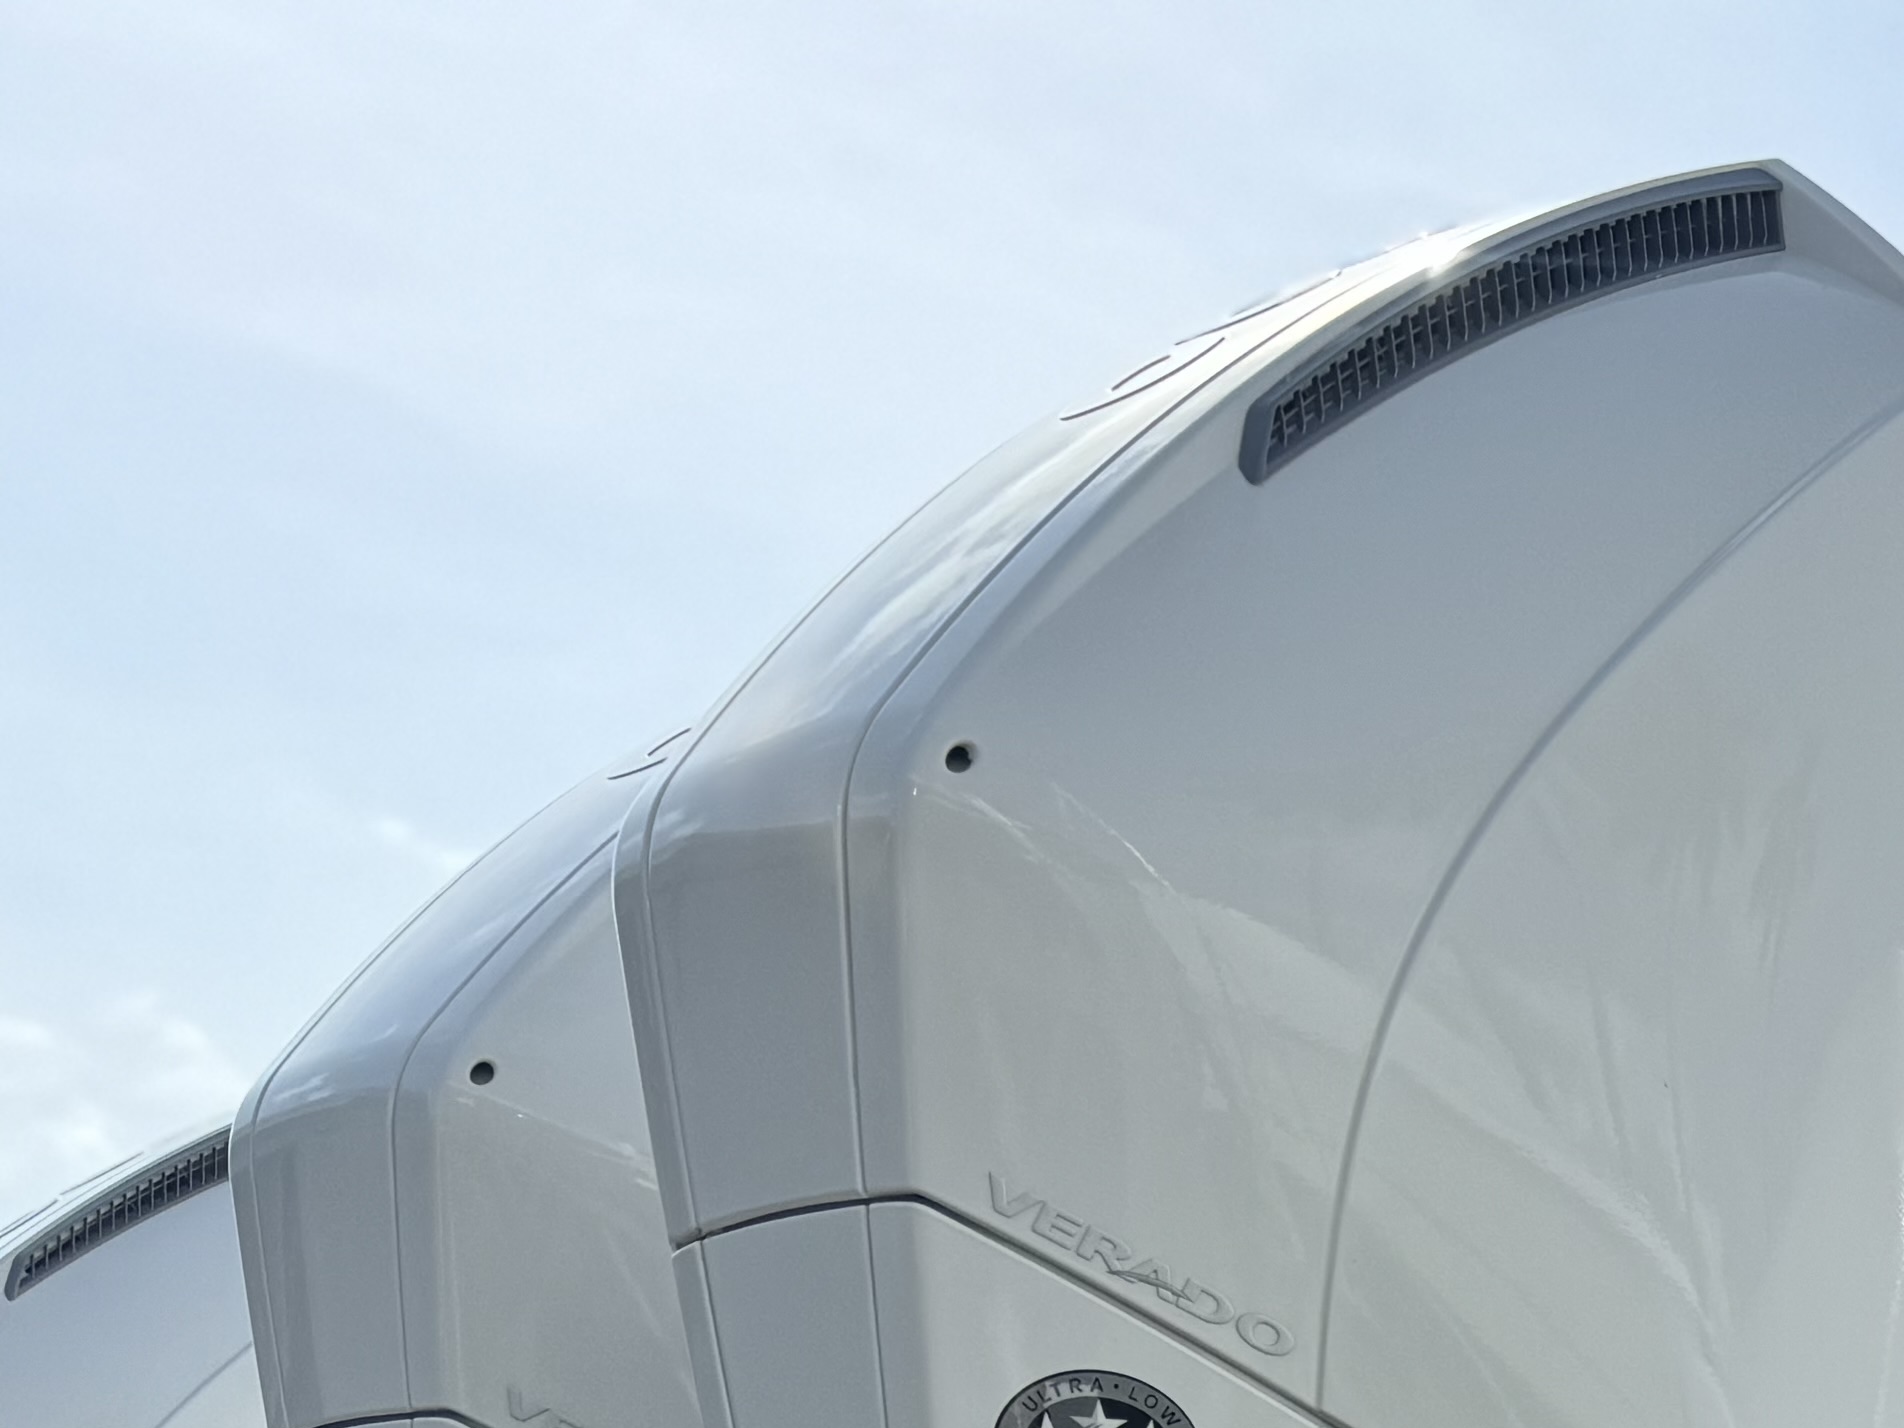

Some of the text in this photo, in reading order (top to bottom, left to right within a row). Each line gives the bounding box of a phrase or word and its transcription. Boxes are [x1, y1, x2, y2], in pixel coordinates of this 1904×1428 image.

[988, 1171, 1294, 1356] VERADO
[1022, 1377, 1181, 1427] ULTRA LOW
